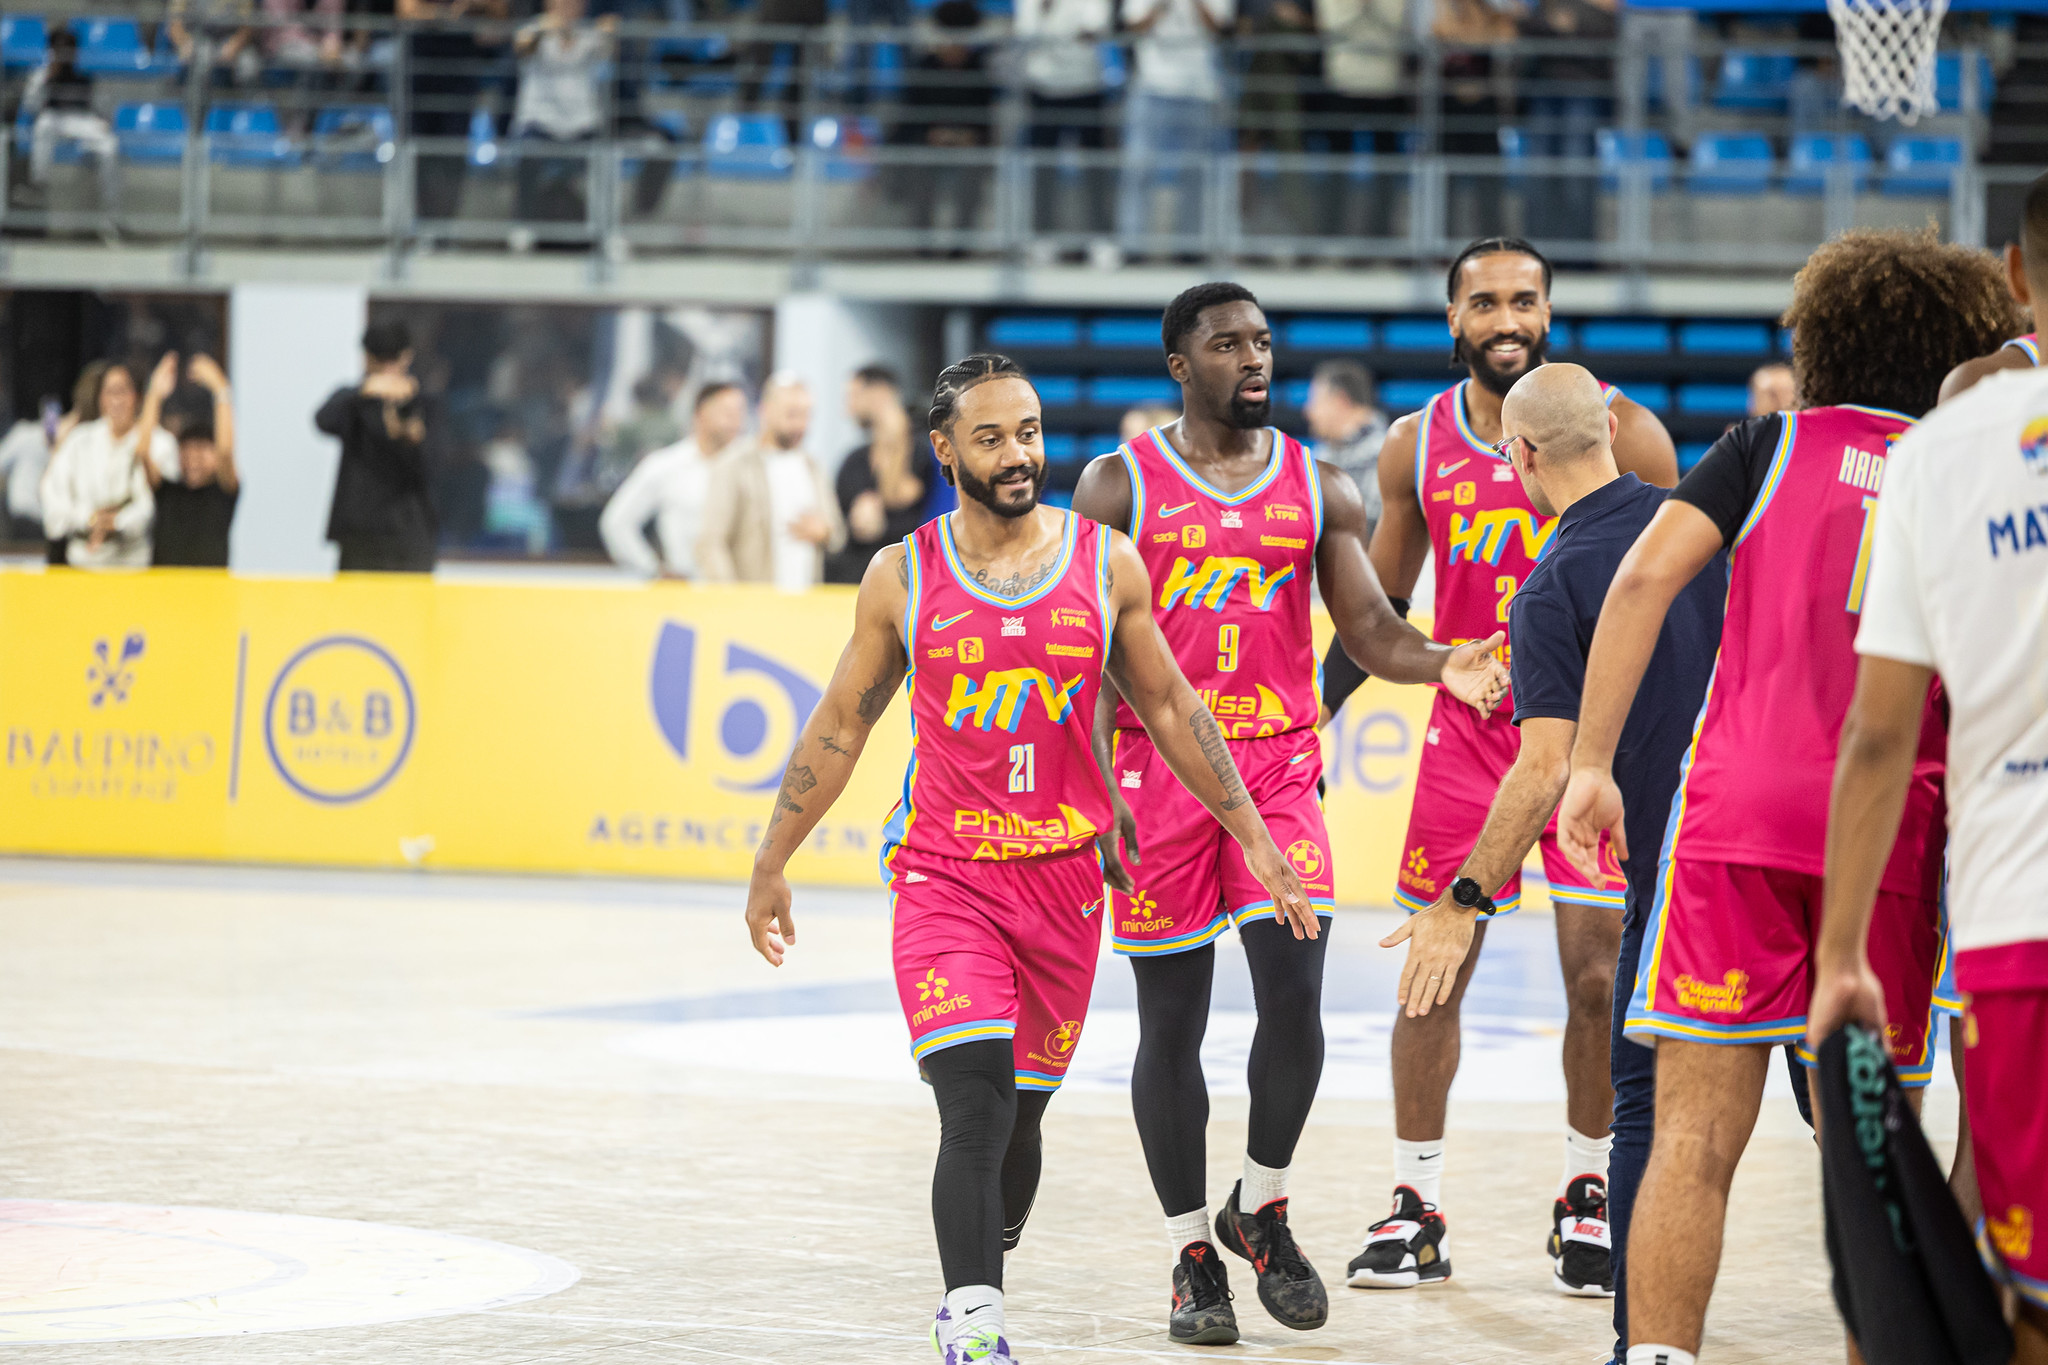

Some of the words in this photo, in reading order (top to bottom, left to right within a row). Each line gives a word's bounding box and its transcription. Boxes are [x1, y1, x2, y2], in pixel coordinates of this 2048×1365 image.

[1449, 507, 1560, 566] HTV
[1987, 503, 2048, 559] MA
[1159, 556, 1295, 613] HTV
[1061, 616, 1086, 628] TPM
[927, 646, 953, 659] sade
[1217, 624, 1240, 672] 9
[944, 667, 1085, 733] HTV
[1196, 689, 1257, 715] lisa
[1008, 743, 1035, 793] 21
[954, 809, 1066, 837] Philisa
[1121, 916, 1175, 933] mineris
[912, 993, 972, 1027] mineris
